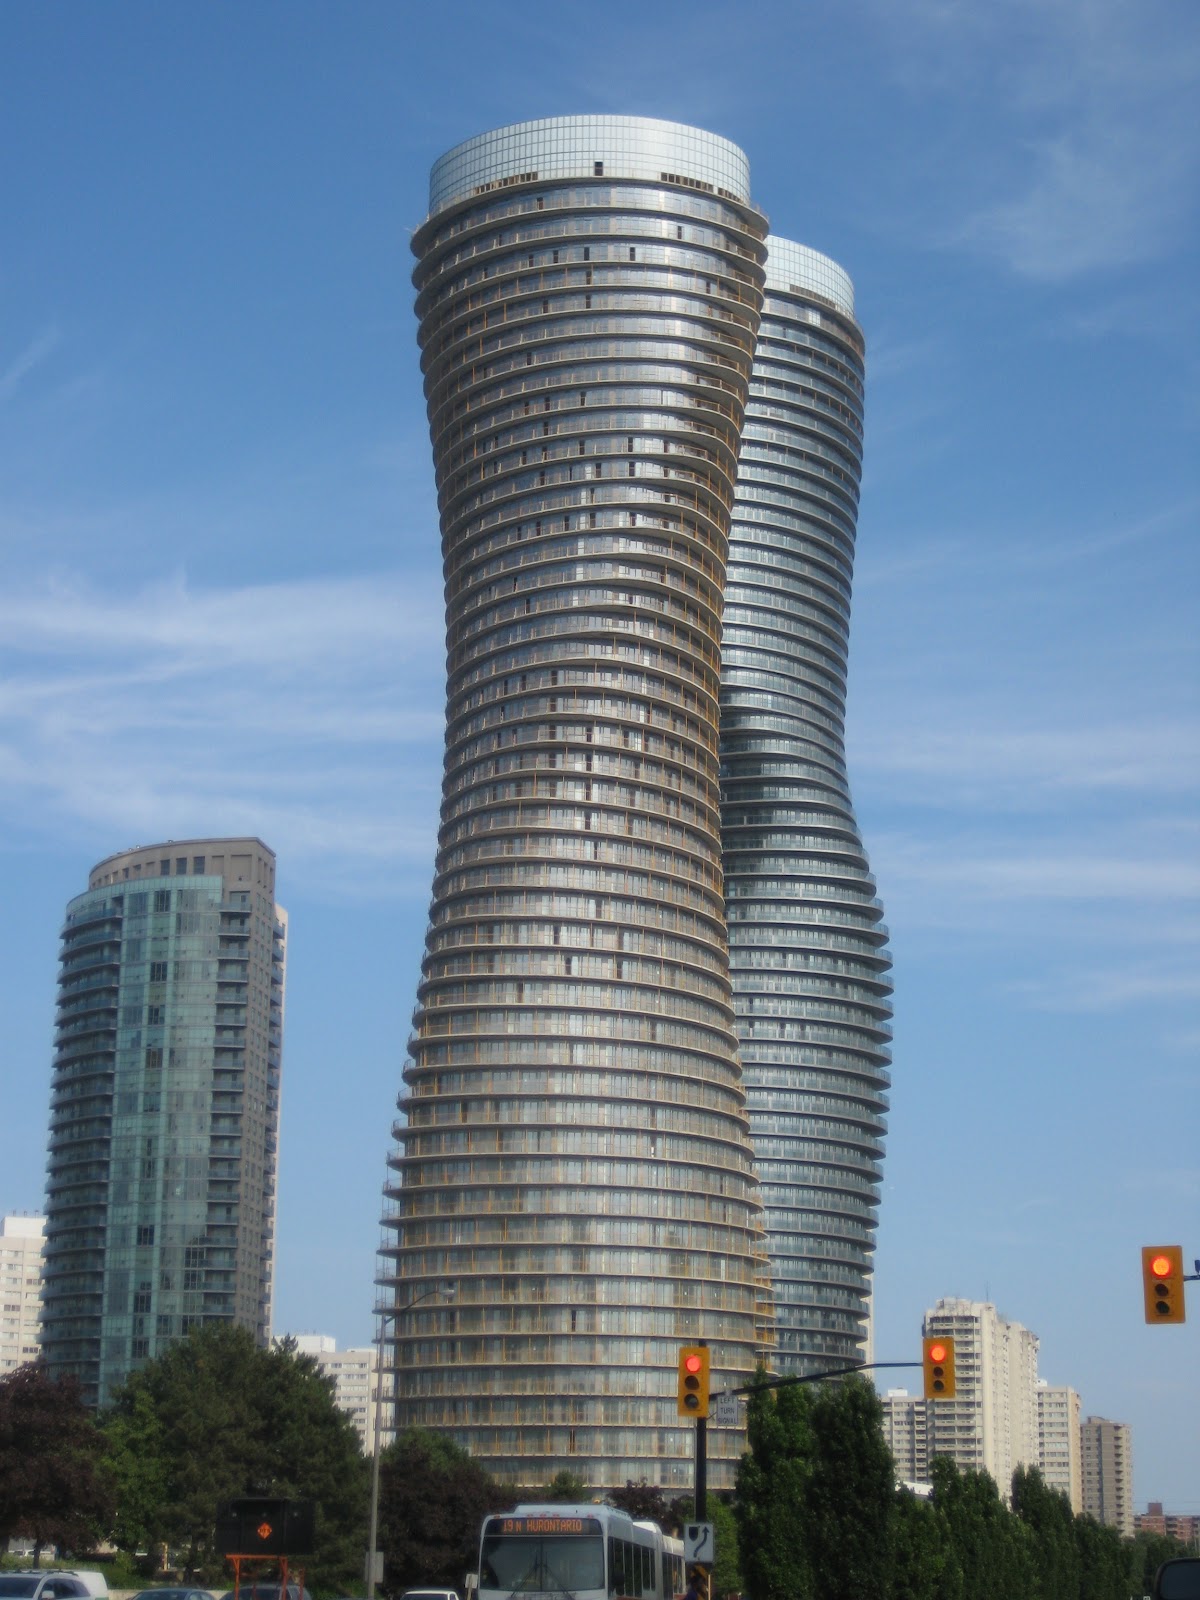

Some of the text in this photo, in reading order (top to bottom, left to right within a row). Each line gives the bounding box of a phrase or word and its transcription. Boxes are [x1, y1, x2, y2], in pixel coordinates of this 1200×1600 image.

[717, 1417, 737, 1425] SIGNAL
[503, 1519, 582, 1533] 19 N HURONTARIO
